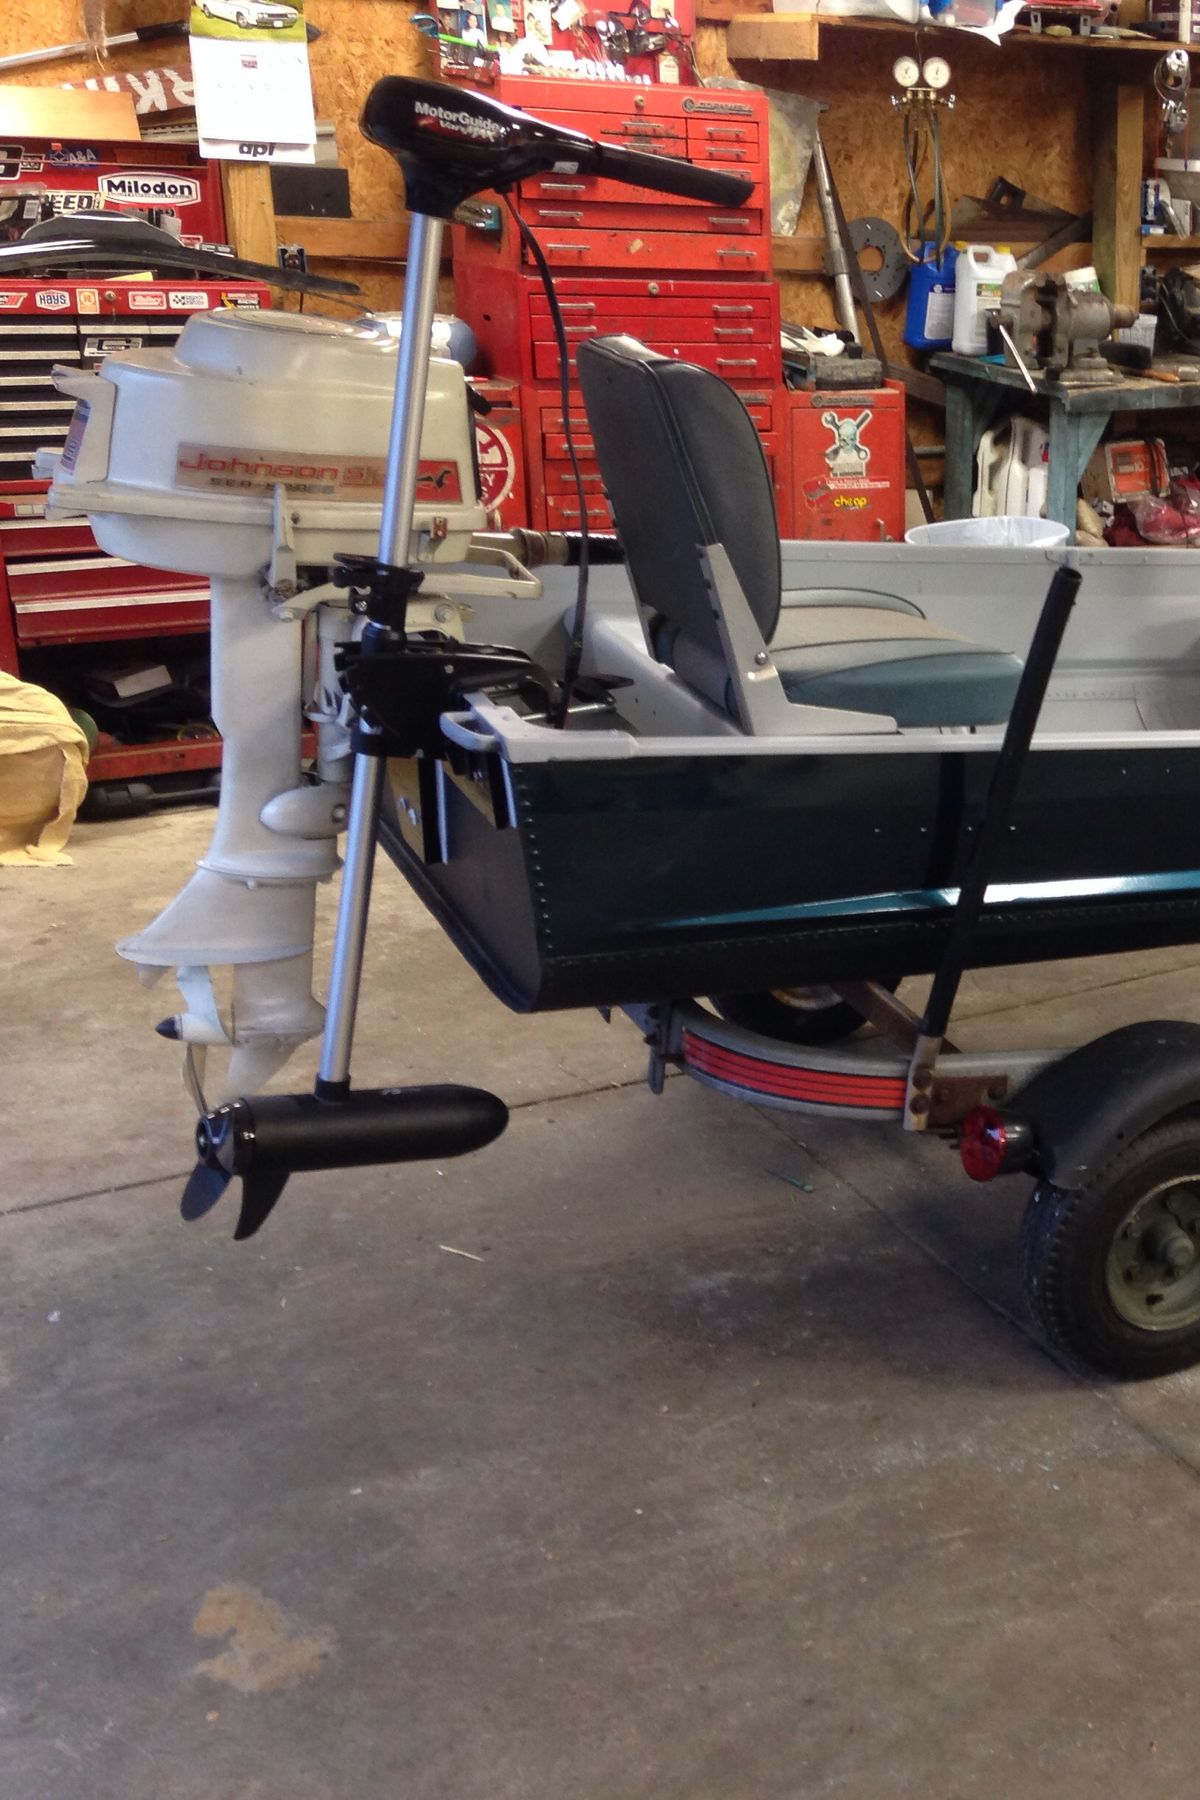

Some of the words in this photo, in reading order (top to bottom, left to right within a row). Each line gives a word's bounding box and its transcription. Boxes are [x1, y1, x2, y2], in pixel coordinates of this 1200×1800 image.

[414, 101, 500, 131] MotorGuide
[105, 179, 193, 197] Milodon
[179, 453, 339, 480] Johnson
